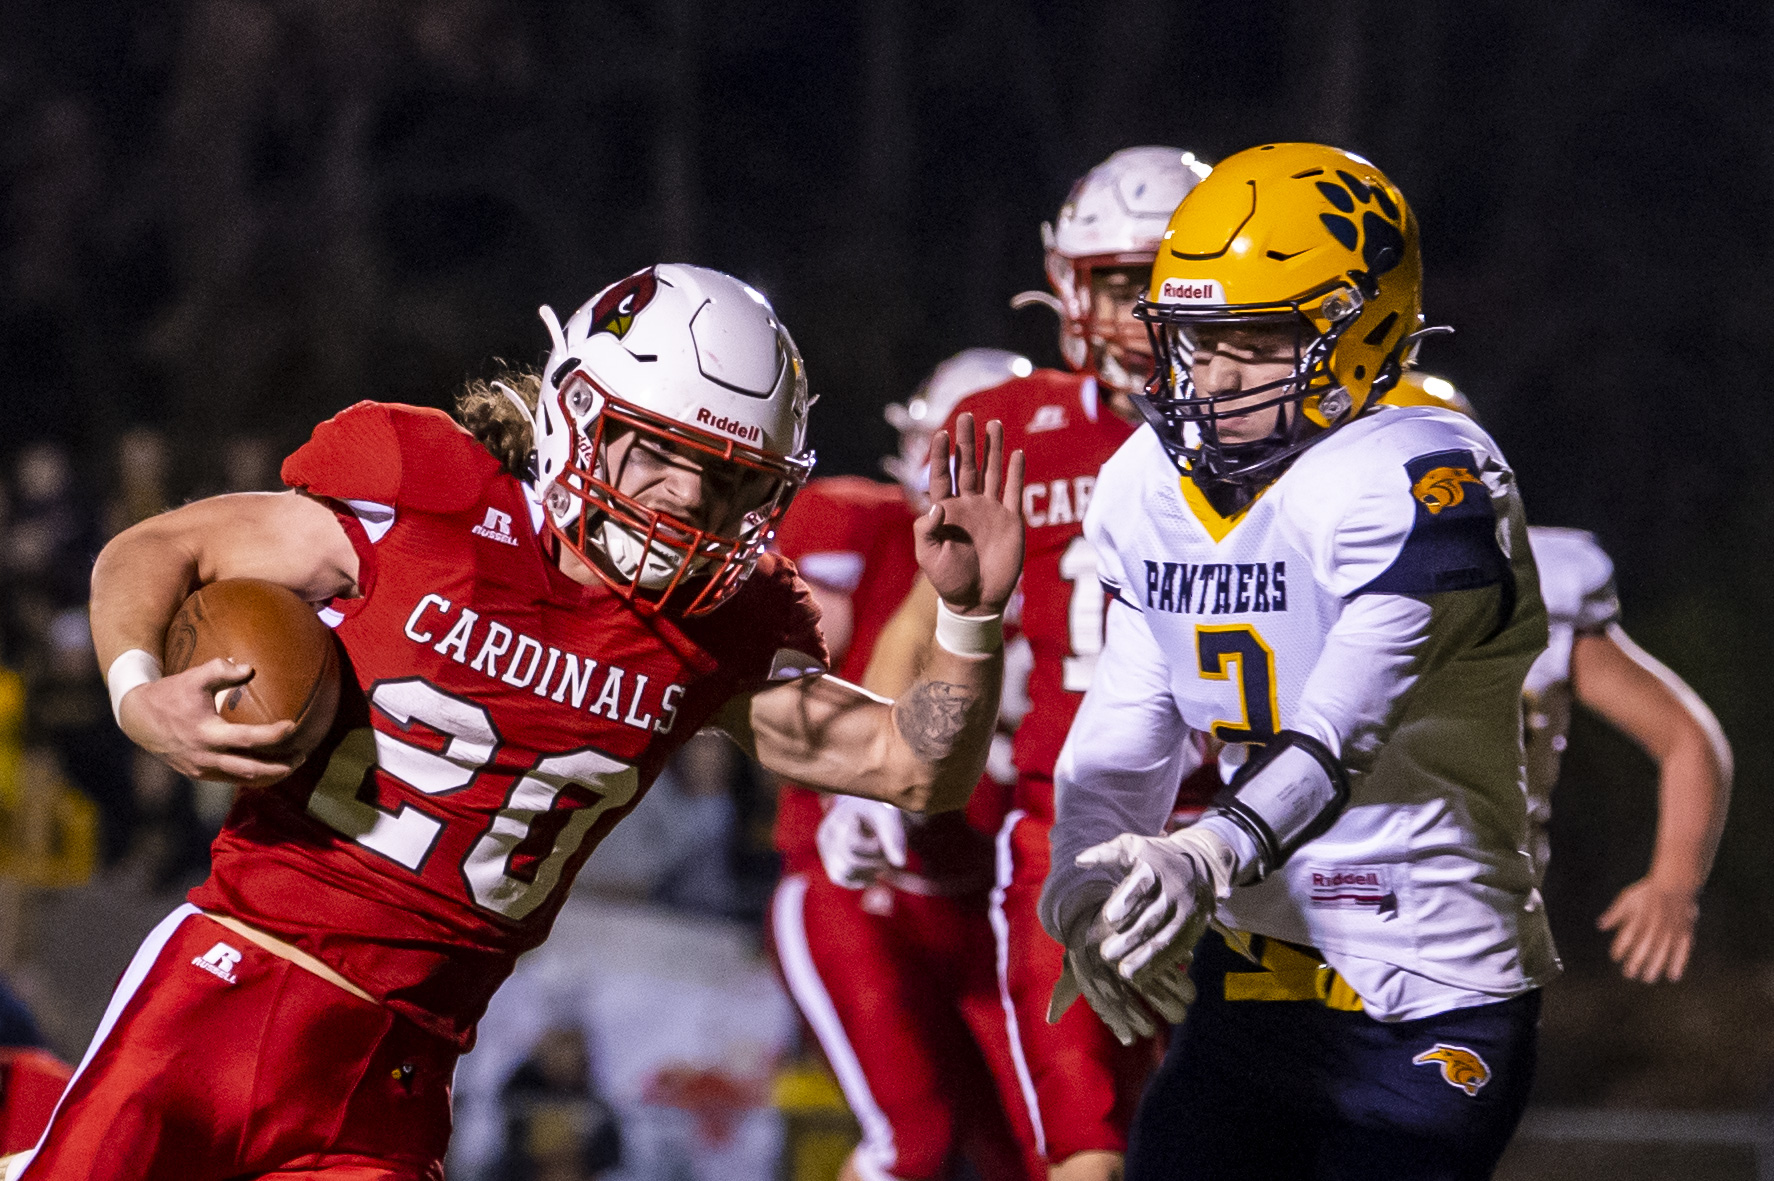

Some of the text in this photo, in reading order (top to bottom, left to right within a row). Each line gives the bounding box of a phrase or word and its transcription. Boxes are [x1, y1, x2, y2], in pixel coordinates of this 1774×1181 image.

[1163, 282, 1213, 299] Riddell
[696, 407, 760, 442] Riddell
[1143, 559, 1288, 615] PANTHERS
[403, 592, 686, 735] CARDINALS
[306, 674, 641, 921] 20
[1312, 872, 1381, 887] Riddell
